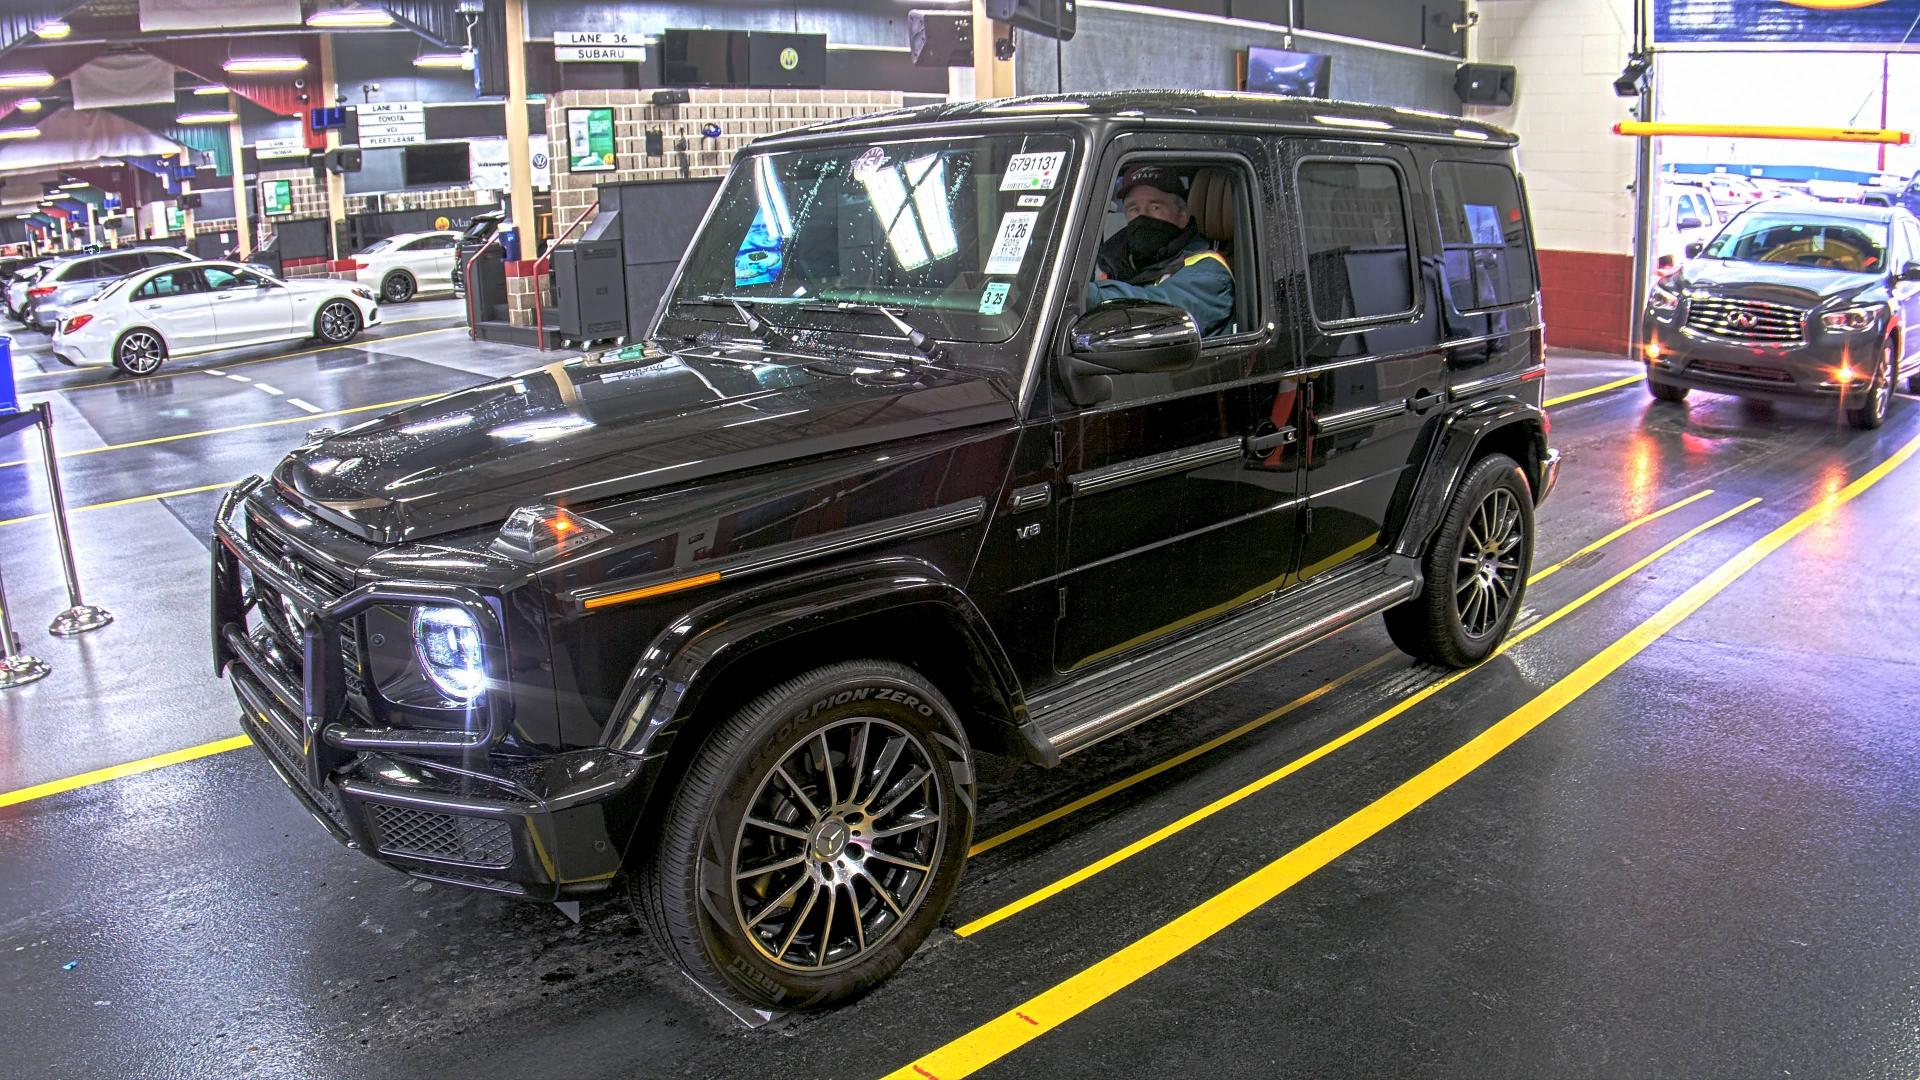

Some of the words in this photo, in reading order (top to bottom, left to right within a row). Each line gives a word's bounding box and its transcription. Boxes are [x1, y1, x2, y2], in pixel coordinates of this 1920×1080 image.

[571, 34, 602, 43] LANE
[614, 34, 628, 43] 36
[578, 49, 625, 59] SUBARU
[372, 104, 391, 112] LANE
[378, 115, 405, 123] TOYOTA
[1009, 155, 1058, 172] 6791131
[984, 291, 992, 304] 3
[992, 292, 1005, 306] 25
[1016, 523, 1041, 540] V8
[873, 687, 934, 717] ZERO
